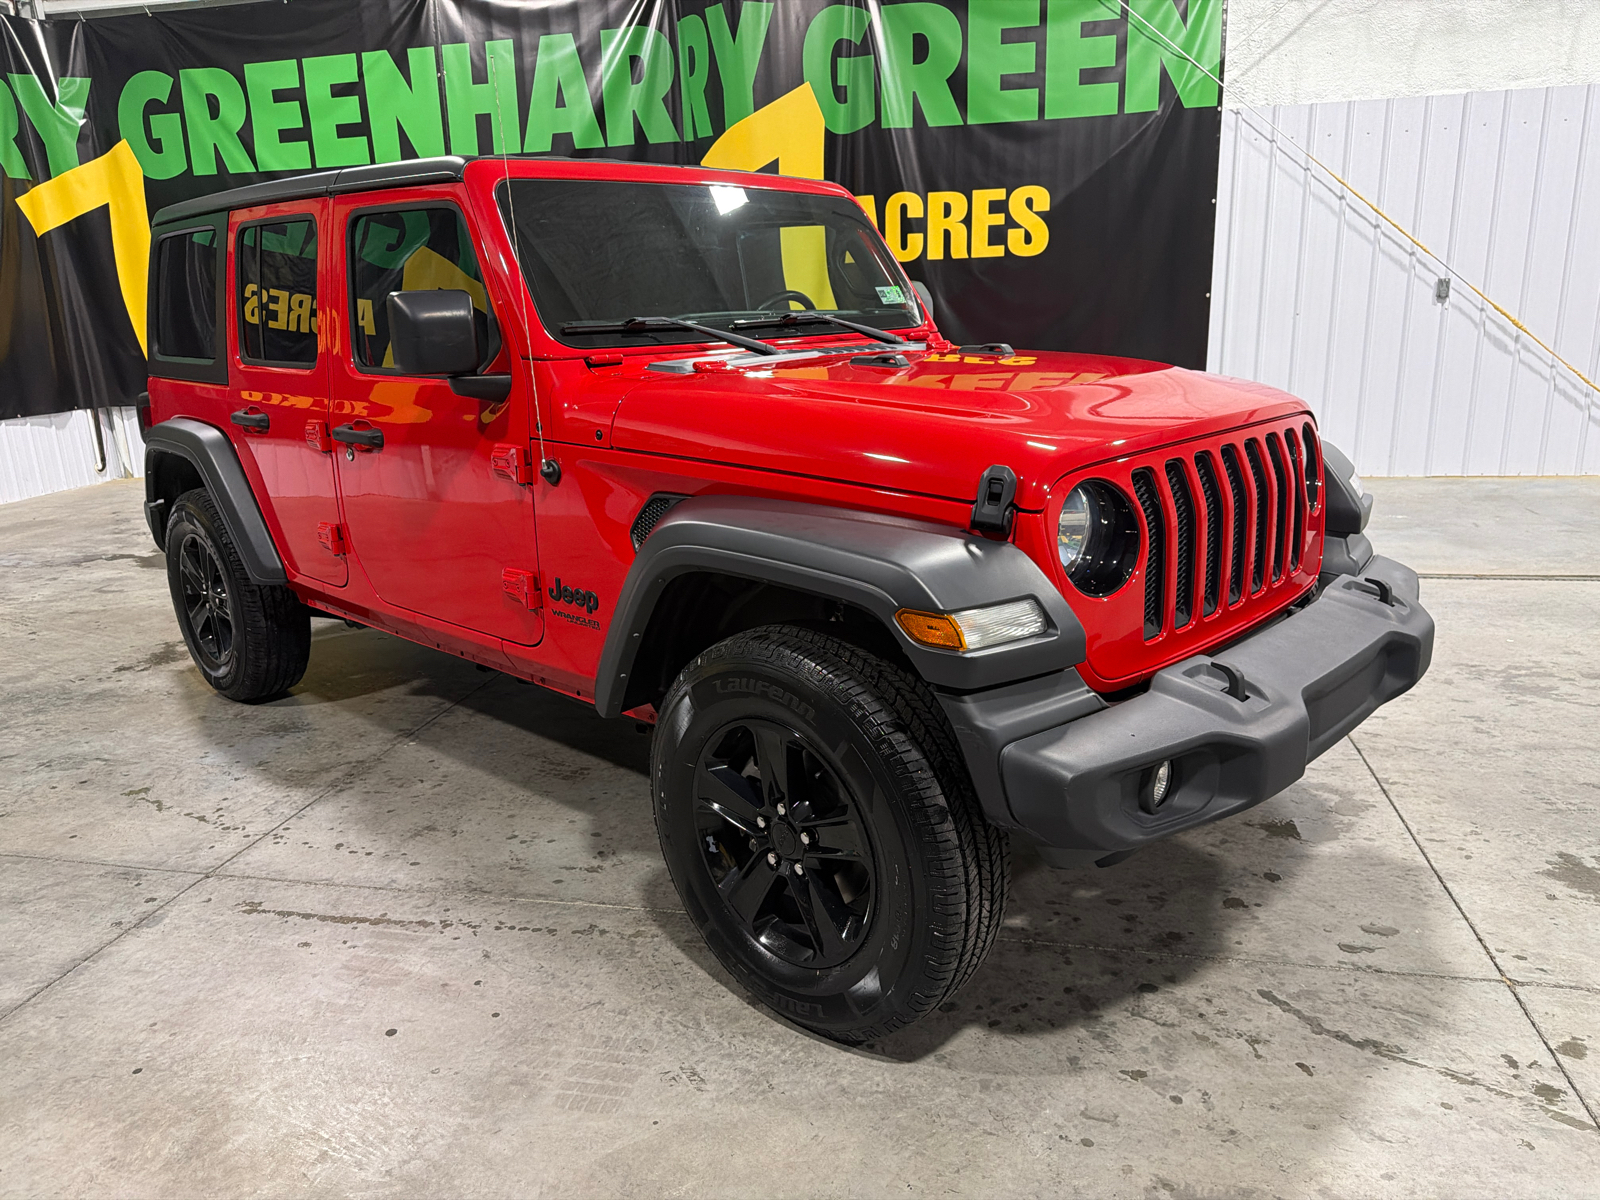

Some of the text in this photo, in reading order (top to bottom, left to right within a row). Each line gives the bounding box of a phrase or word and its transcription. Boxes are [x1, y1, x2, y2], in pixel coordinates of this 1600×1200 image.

[118, 46, 446, 180] GREEN
[442, 0, 1222, 156] HARRY GREEN
[548, 577, 598, 614] Jeep
[551, 608, 599, 627] WRANGLER
